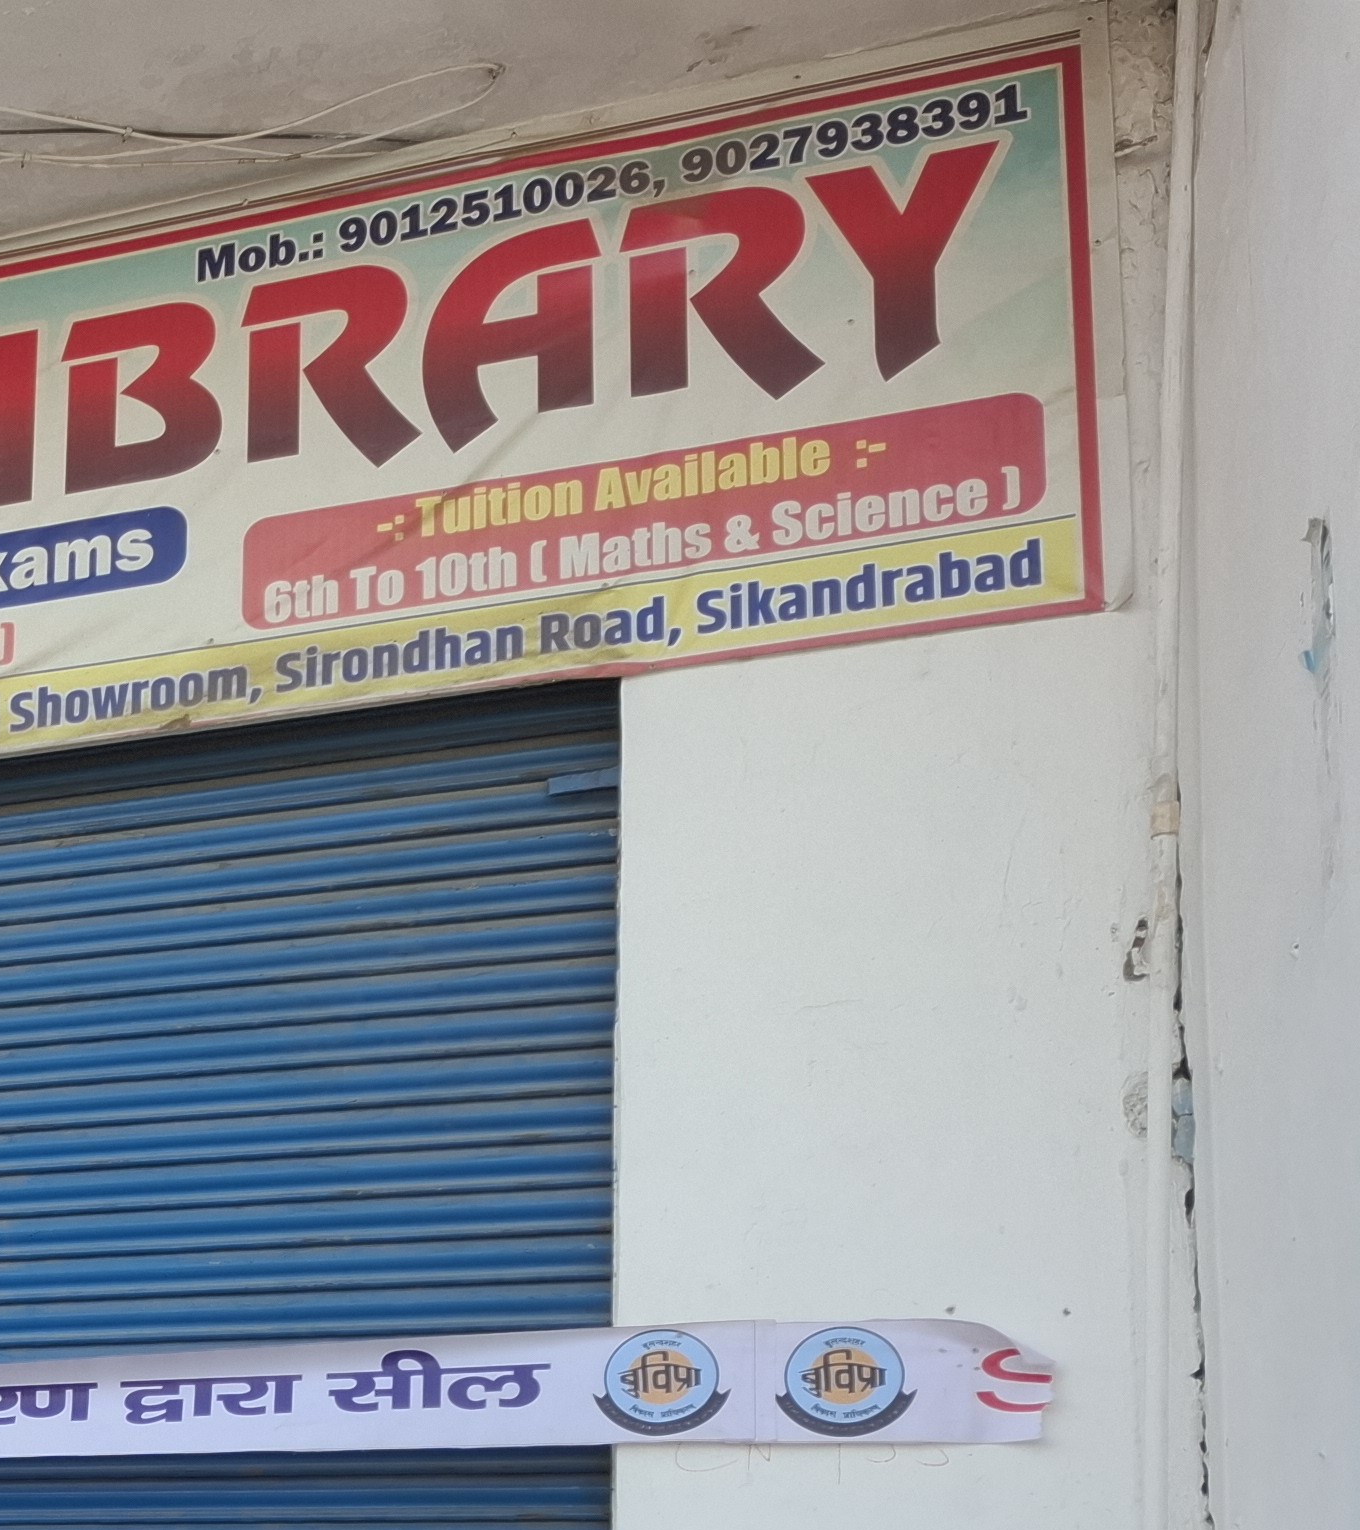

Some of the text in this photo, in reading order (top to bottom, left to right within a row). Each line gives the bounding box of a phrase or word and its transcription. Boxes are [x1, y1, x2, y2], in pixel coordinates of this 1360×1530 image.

[195, 83, 1031, 284] Mob.: 9012510026, 9027938391
[263, 574, 339, 623] 6th
[350, 565, 405, 609] To
[422, 547, 517, 599] 10th
[559, 522, 712, 579] Maths
[723, 514, 760, 553] &
[772, 478, 988, 547] Science
[415, 478, 583, 538] Tuition
[595, 437, 831, 511] Available
[9, 665, 262, 732] Showroom,
[275, 624, 525, 692] Sirondhan
[539, 596, 682, 654] Road,
[696, 538, 1043, 634] Sikandrabad
[120, 1373, 302, 1426] द्वारा
[326, 1349, 552, 1415] सील
